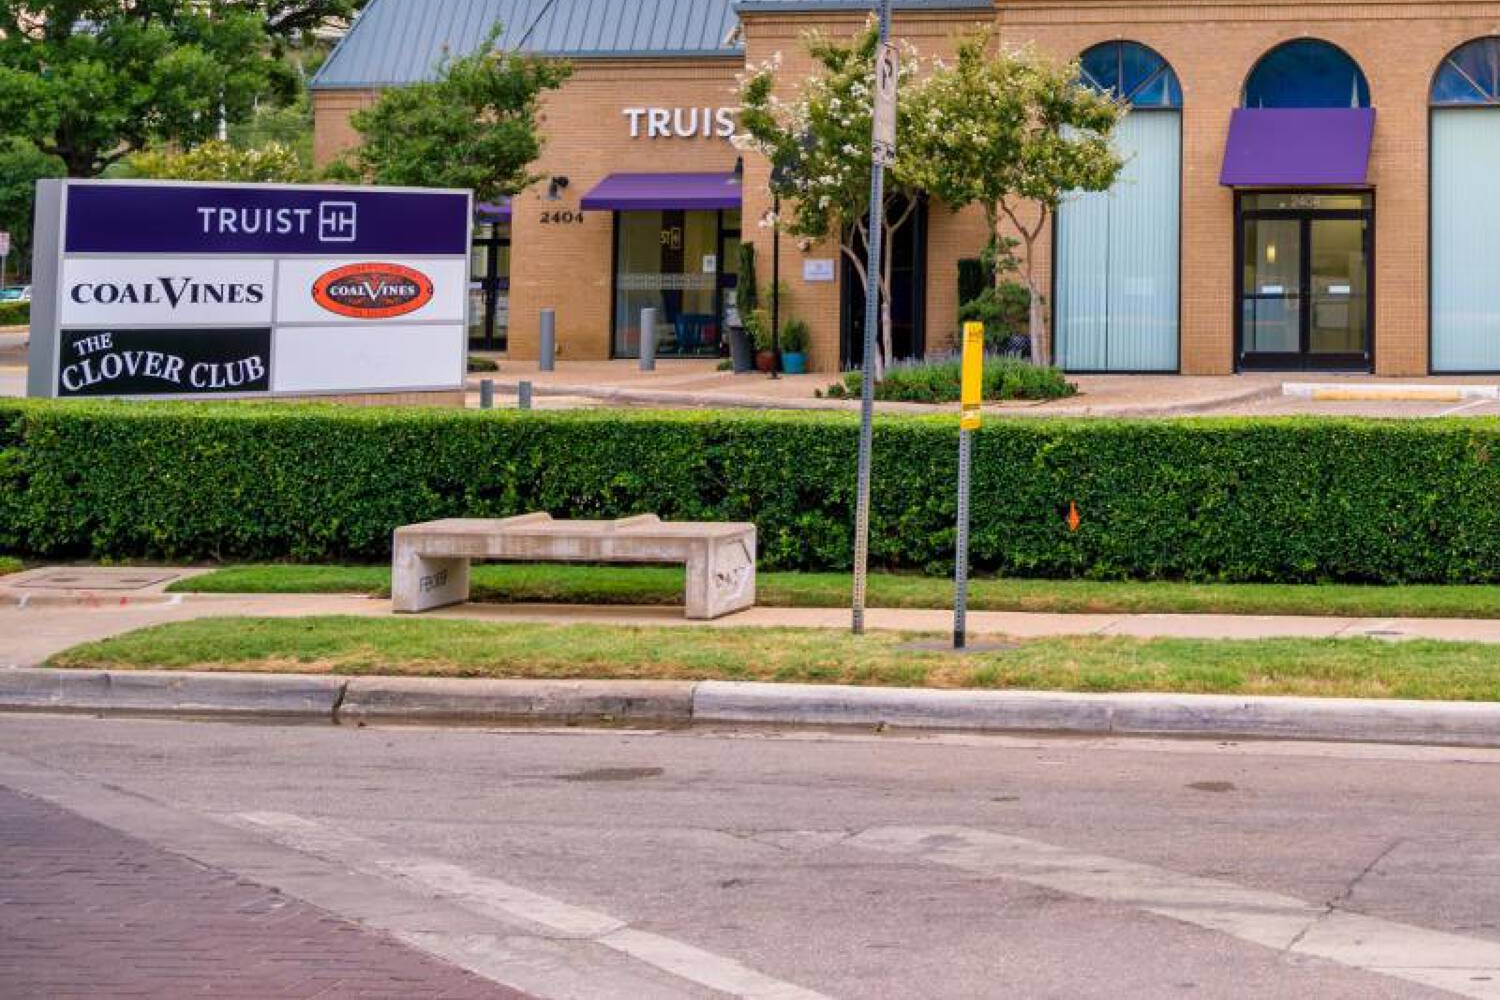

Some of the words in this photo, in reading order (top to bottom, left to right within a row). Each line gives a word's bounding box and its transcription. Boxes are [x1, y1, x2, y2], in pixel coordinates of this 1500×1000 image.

[622, 106, 740, 137] TRUIS
[198, 206, 312, 234] TRUIST
[540, 211, 584, 225] 2404
[73, 332, 113, 356] THE
[61, 350, 185, 392] CLOVER
[189, 354, 266, 389] CLUB
